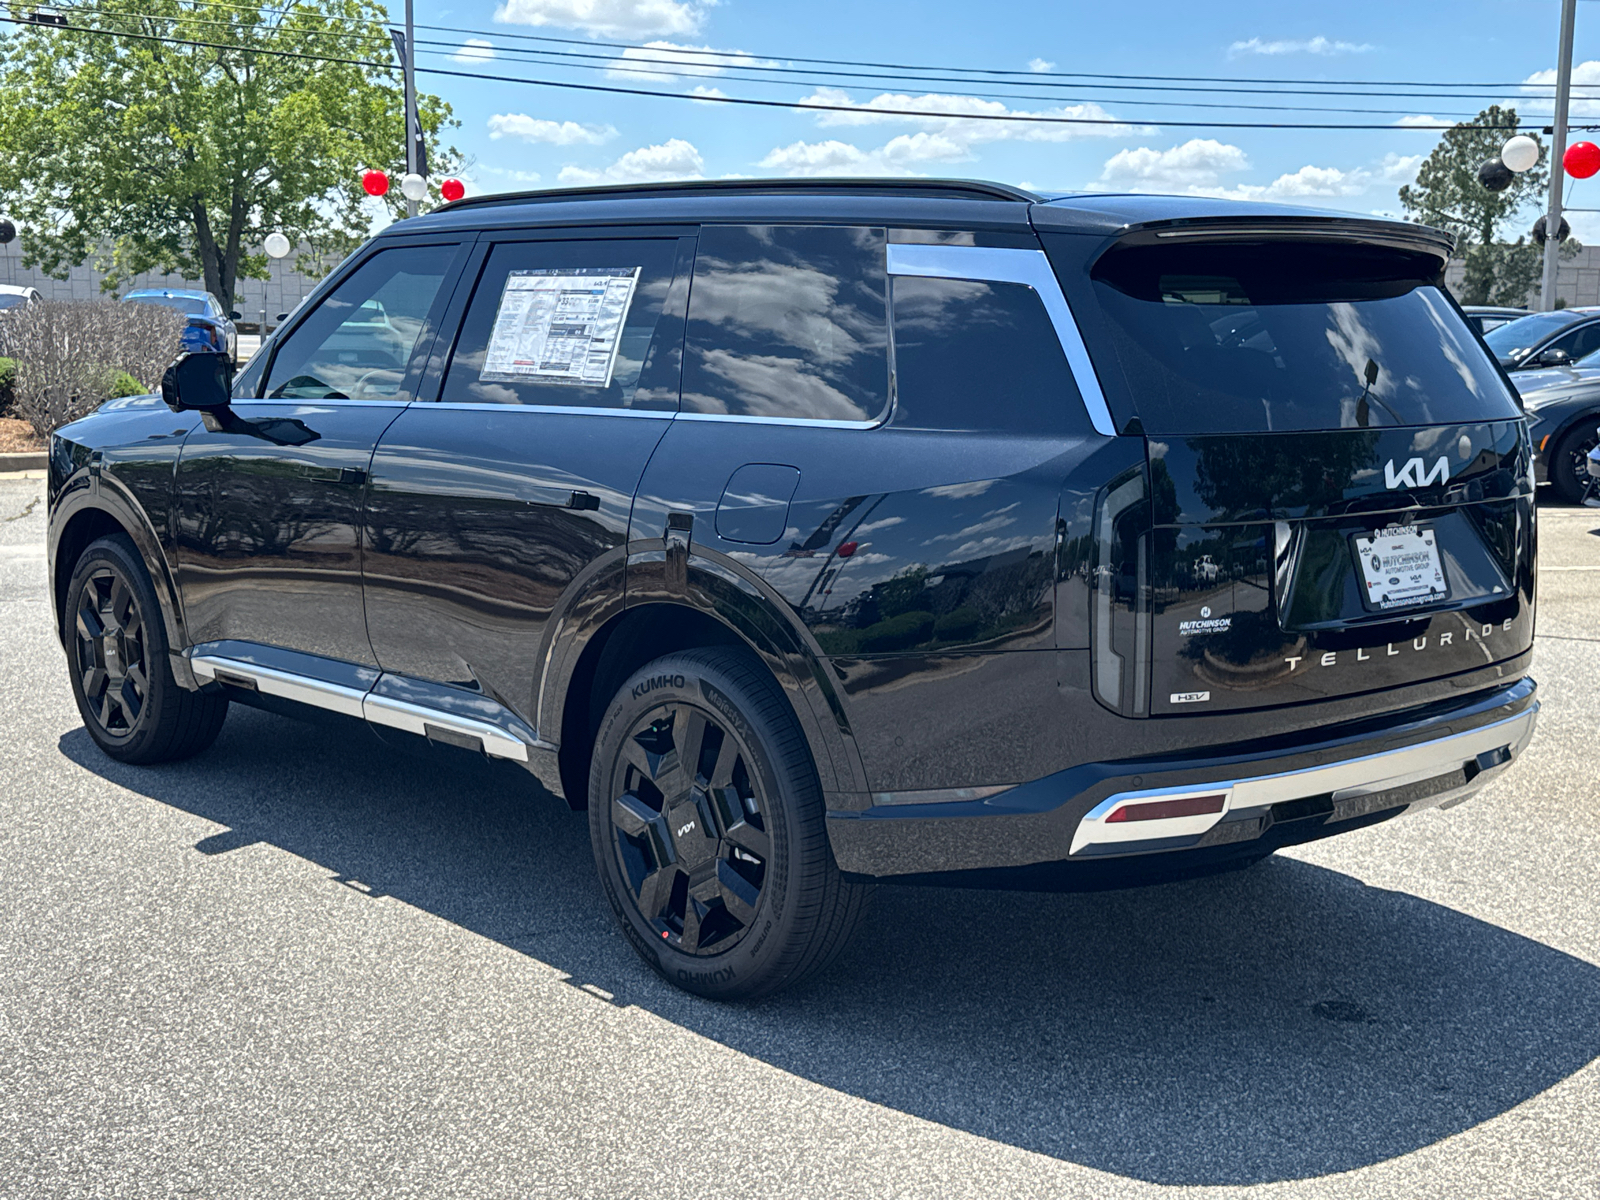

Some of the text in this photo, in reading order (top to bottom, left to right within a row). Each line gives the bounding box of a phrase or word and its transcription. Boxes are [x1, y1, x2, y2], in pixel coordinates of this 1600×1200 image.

[1384, 456, 1450, 490] KIA
[1381, 525, 1418, 537] HUTCHINSON
[1382, 551, 1431, 568] HUTCHINSON
[1385, 562, 1430, 575] AUTOMOTIVE GROUP
[1180, 618, 1231, 630] HUTCHINSON
[1180, 626, 1229, 636] AUTOMOTIVE GROUP
[1285, 618, 1512, 671] TELLURIDE
[631, 674, 685, 701] KUMHO
[1178, 693, 1206, 702] HEV
[707, 689, 742, 727] Majesty
[749, 919, 772, 958] OUTSIDE
[676, 965, 737, 985] KUMHO
